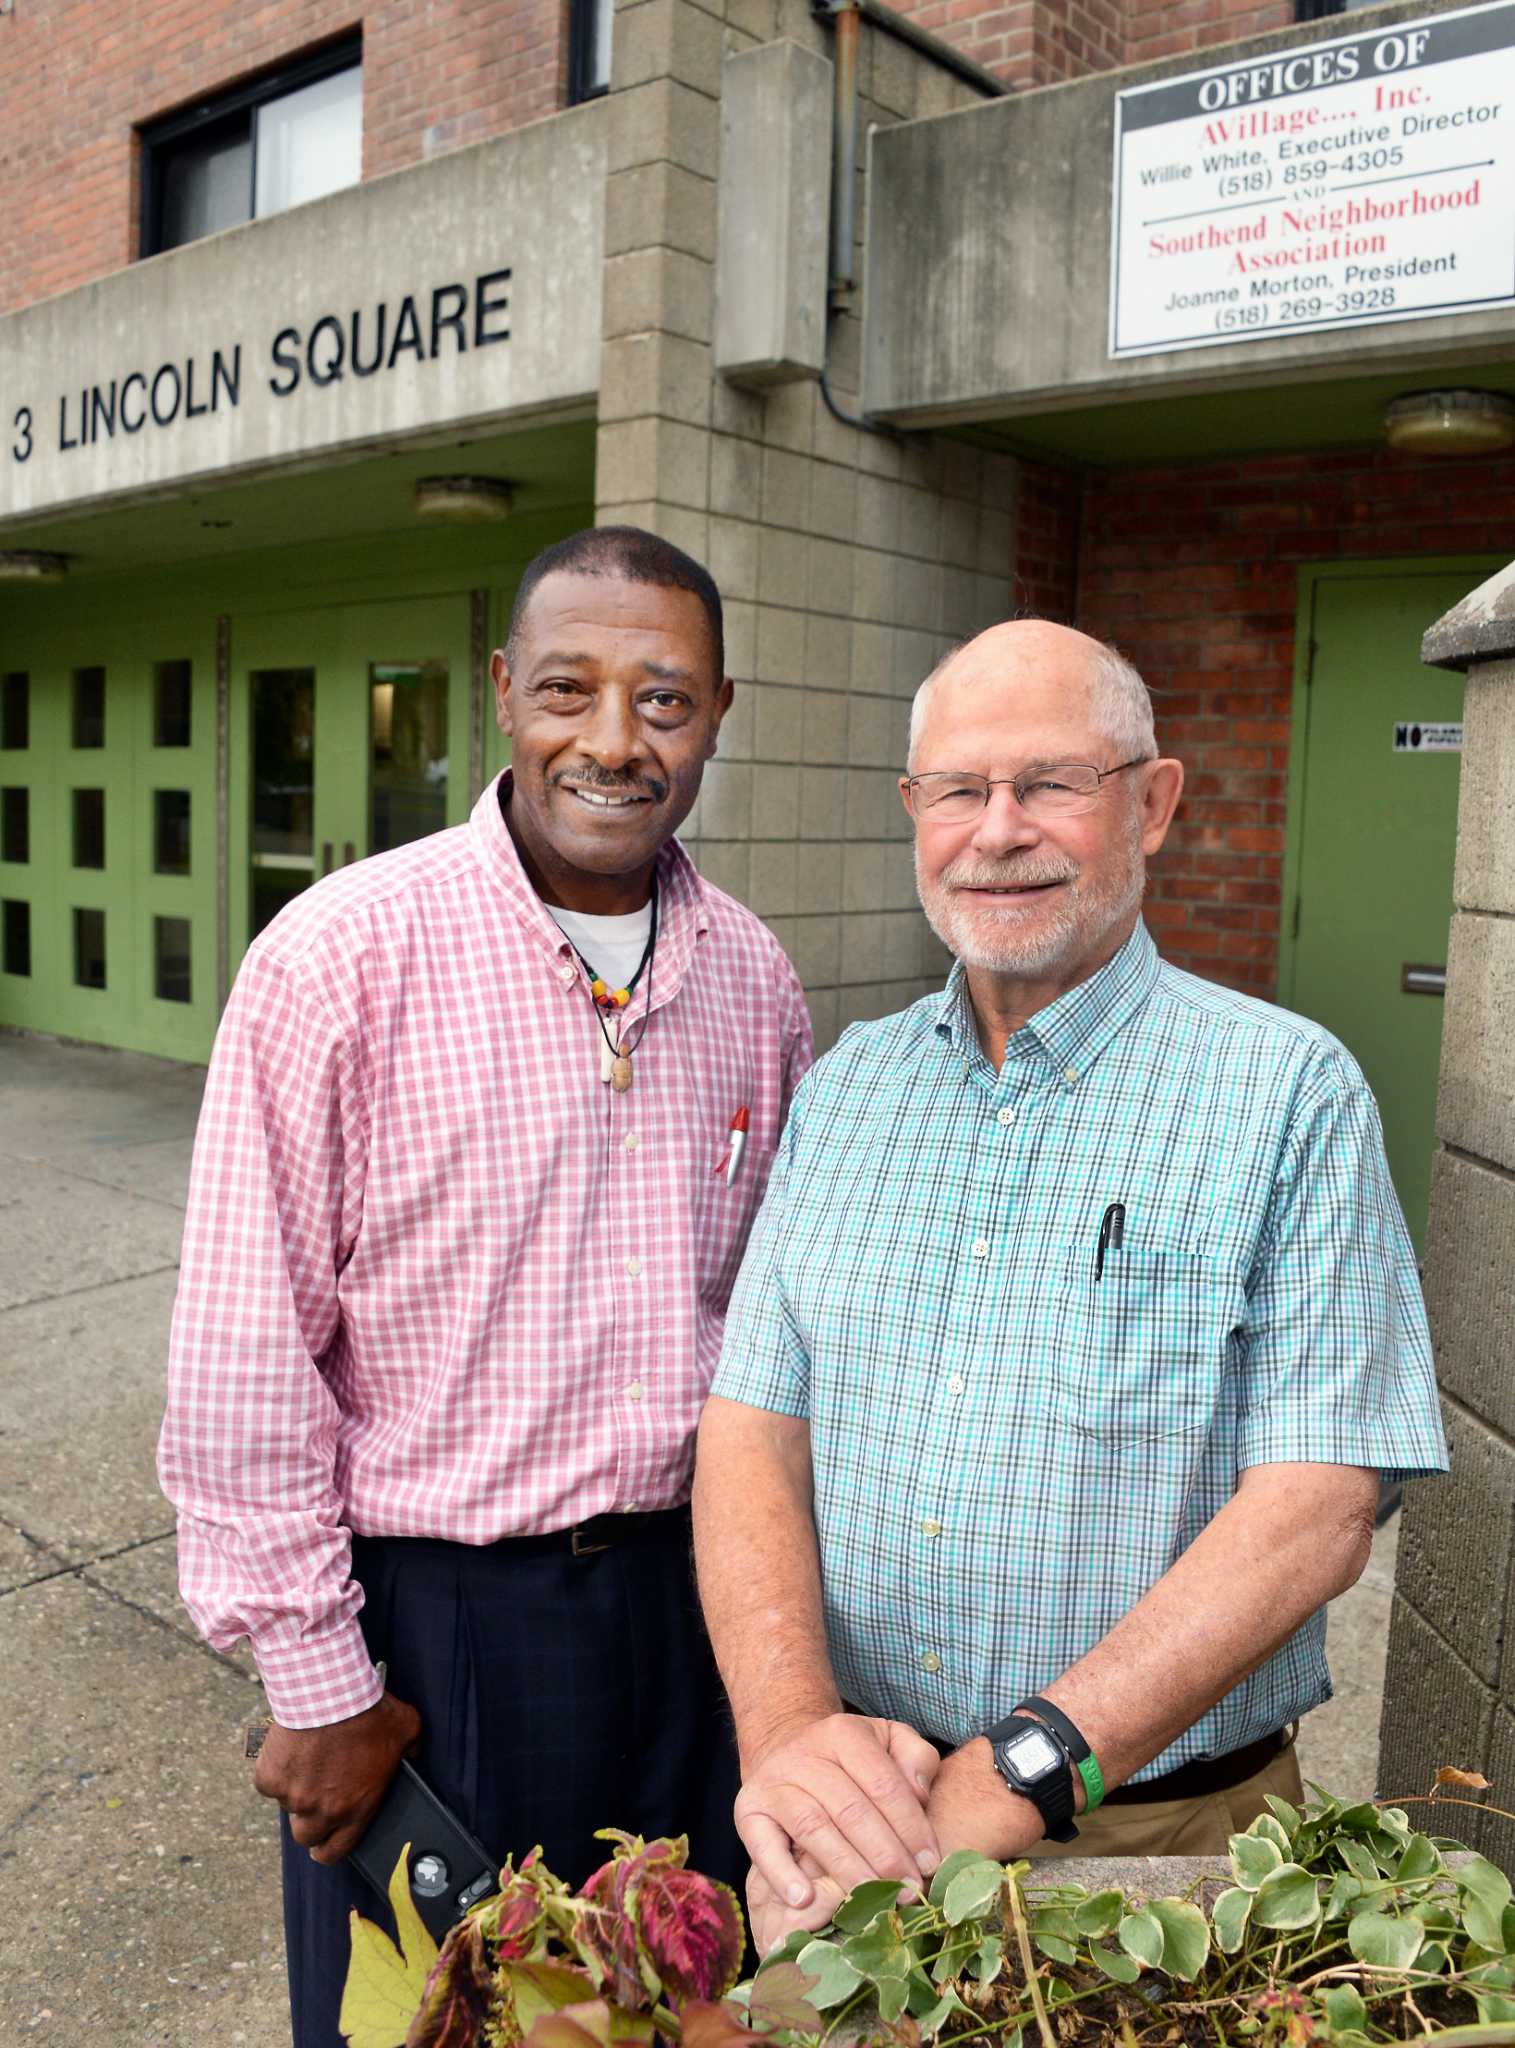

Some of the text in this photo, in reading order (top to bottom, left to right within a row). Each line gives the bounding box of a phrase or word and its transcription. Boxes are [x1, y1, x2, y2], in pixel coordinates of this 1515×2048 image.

[1199, 29, 1431, 112] OFFICES OF
[1375, 85, 1431, 112] Inc.
[1140, 103, 1501, 188] Willie White, Executive Director
[1218, 146, 1404, 198] (518) 859-4305
[1148, 179, 1481, 258] Southend Neighborhood
[1164, 252, 1457, 312] Joanne Morton, President
[1229, 233, 1387, 276] Association
[1215, 287, 1396, 330] (518) 269-3928
[12, 268, 512, 463] 3 LINCOLN SQUARE
